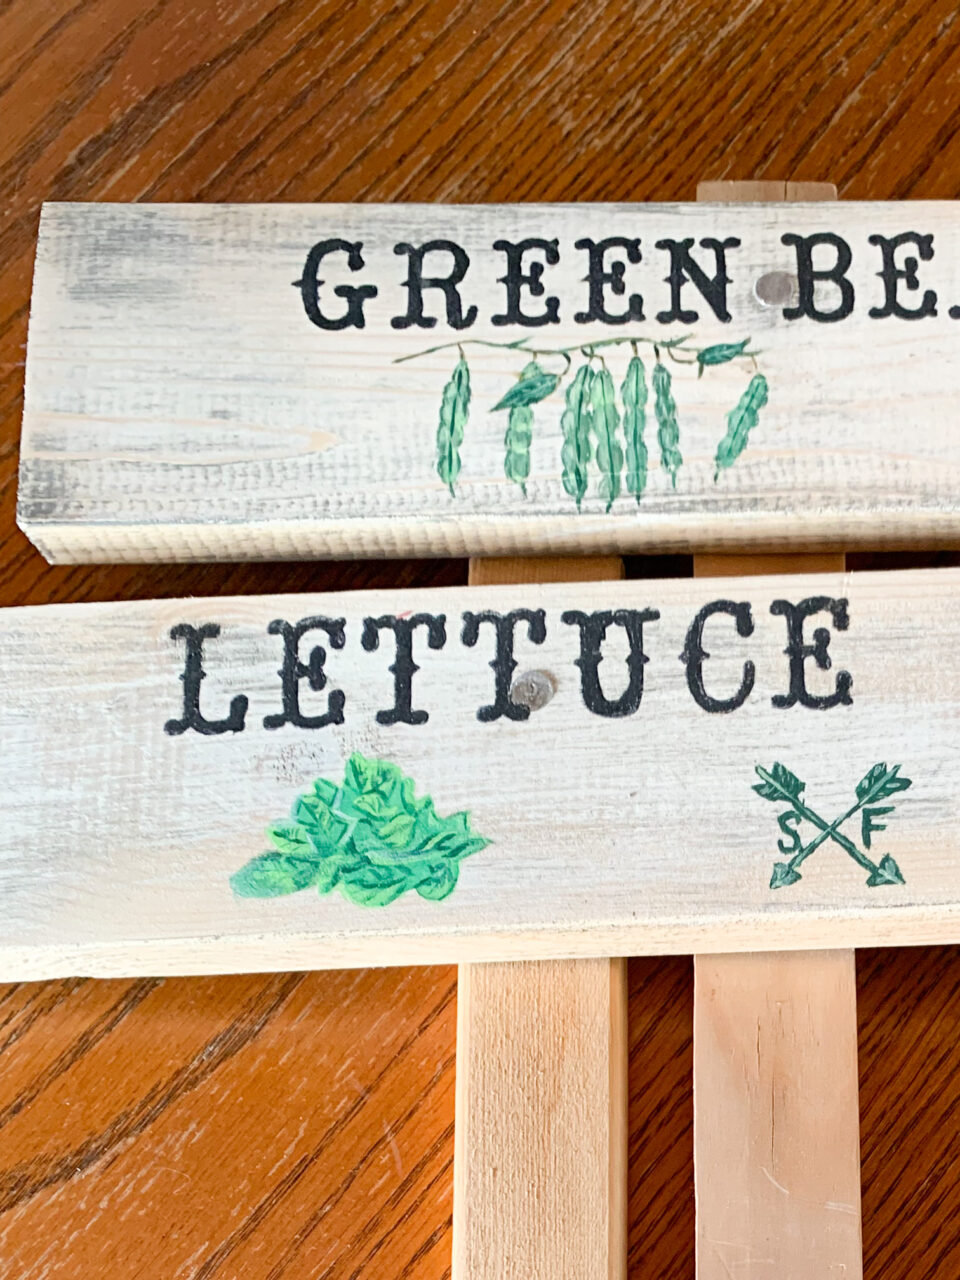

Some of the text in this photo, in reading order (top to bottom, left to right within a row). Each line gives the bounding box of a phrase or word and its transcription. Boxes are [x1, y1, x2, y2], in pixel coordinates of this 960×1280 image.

[291, 231, 741, 330] GREEN
[165, 596, 854, 736] LETTUCE
[777, 805, 896, 855] S F
